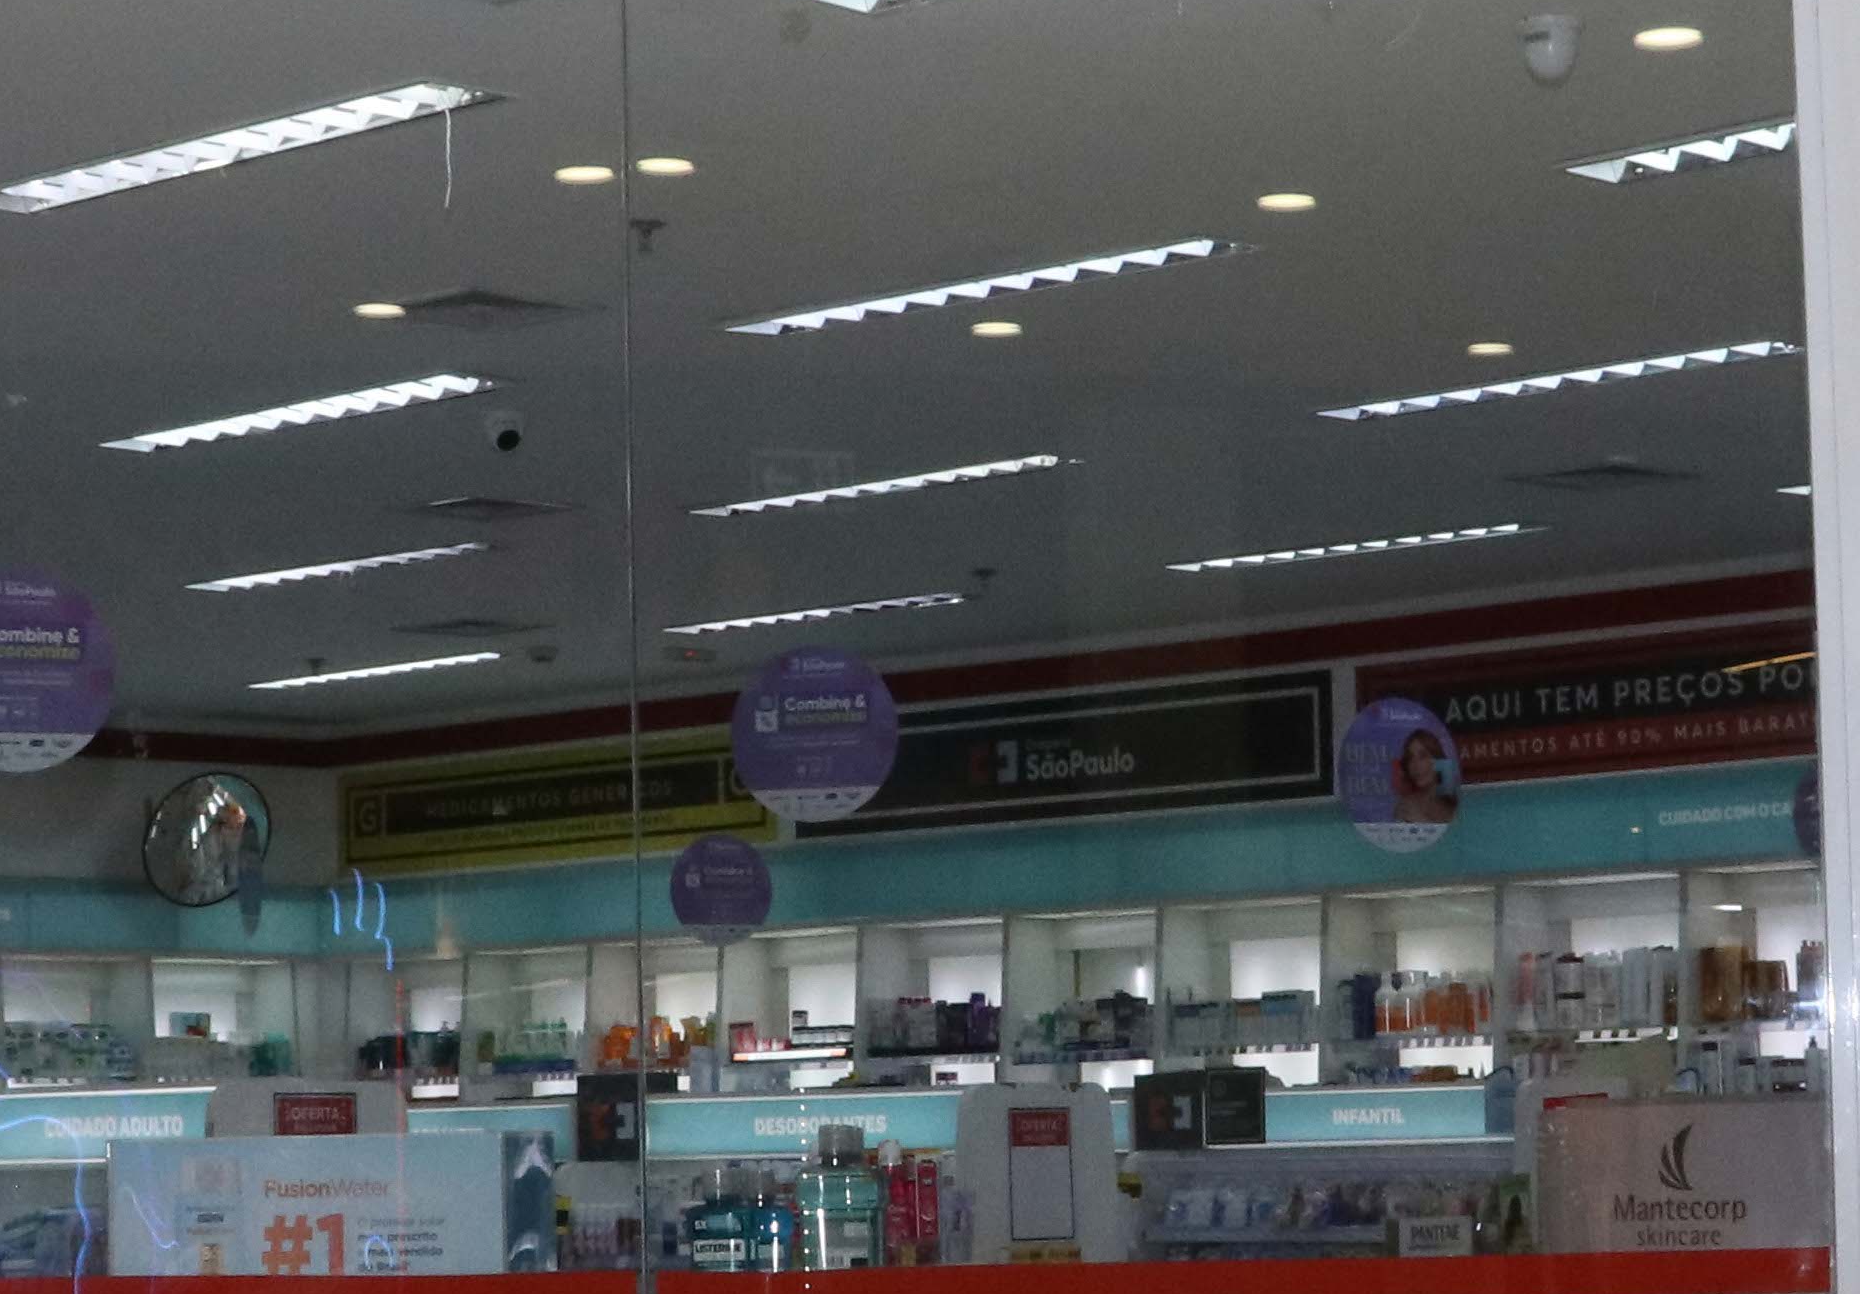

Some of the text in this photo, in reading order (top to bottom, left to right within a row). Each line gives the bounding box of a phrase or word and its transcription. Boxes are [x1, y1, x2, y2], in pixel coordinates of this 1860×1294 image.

[66, 626, 81, 644] &
[784, 695, 850, 711] Combine
[1445, 660, 1817, 725] AQUI TEM PREÇOS PO
[1460, 713, 1817, 761] AMENTOS ATÉ 90% MAIS BARAT
[1025, 746, 1135, 783] SãoPaulo
[1657, 805, 1756, 828] CUIDADO COM
[43, 1113, 184, 1139] CUIDADO ADULTO
[1332, 1108, 1405, 1126] INFANTIL
[1613, 1194, 1747, 1226] Mantecorp
[261, 1213, 345, 1276] #1
[1410, 1223, 1460, 1242] PANTENE
[1636, 1227, 1722, 1247] skincare
